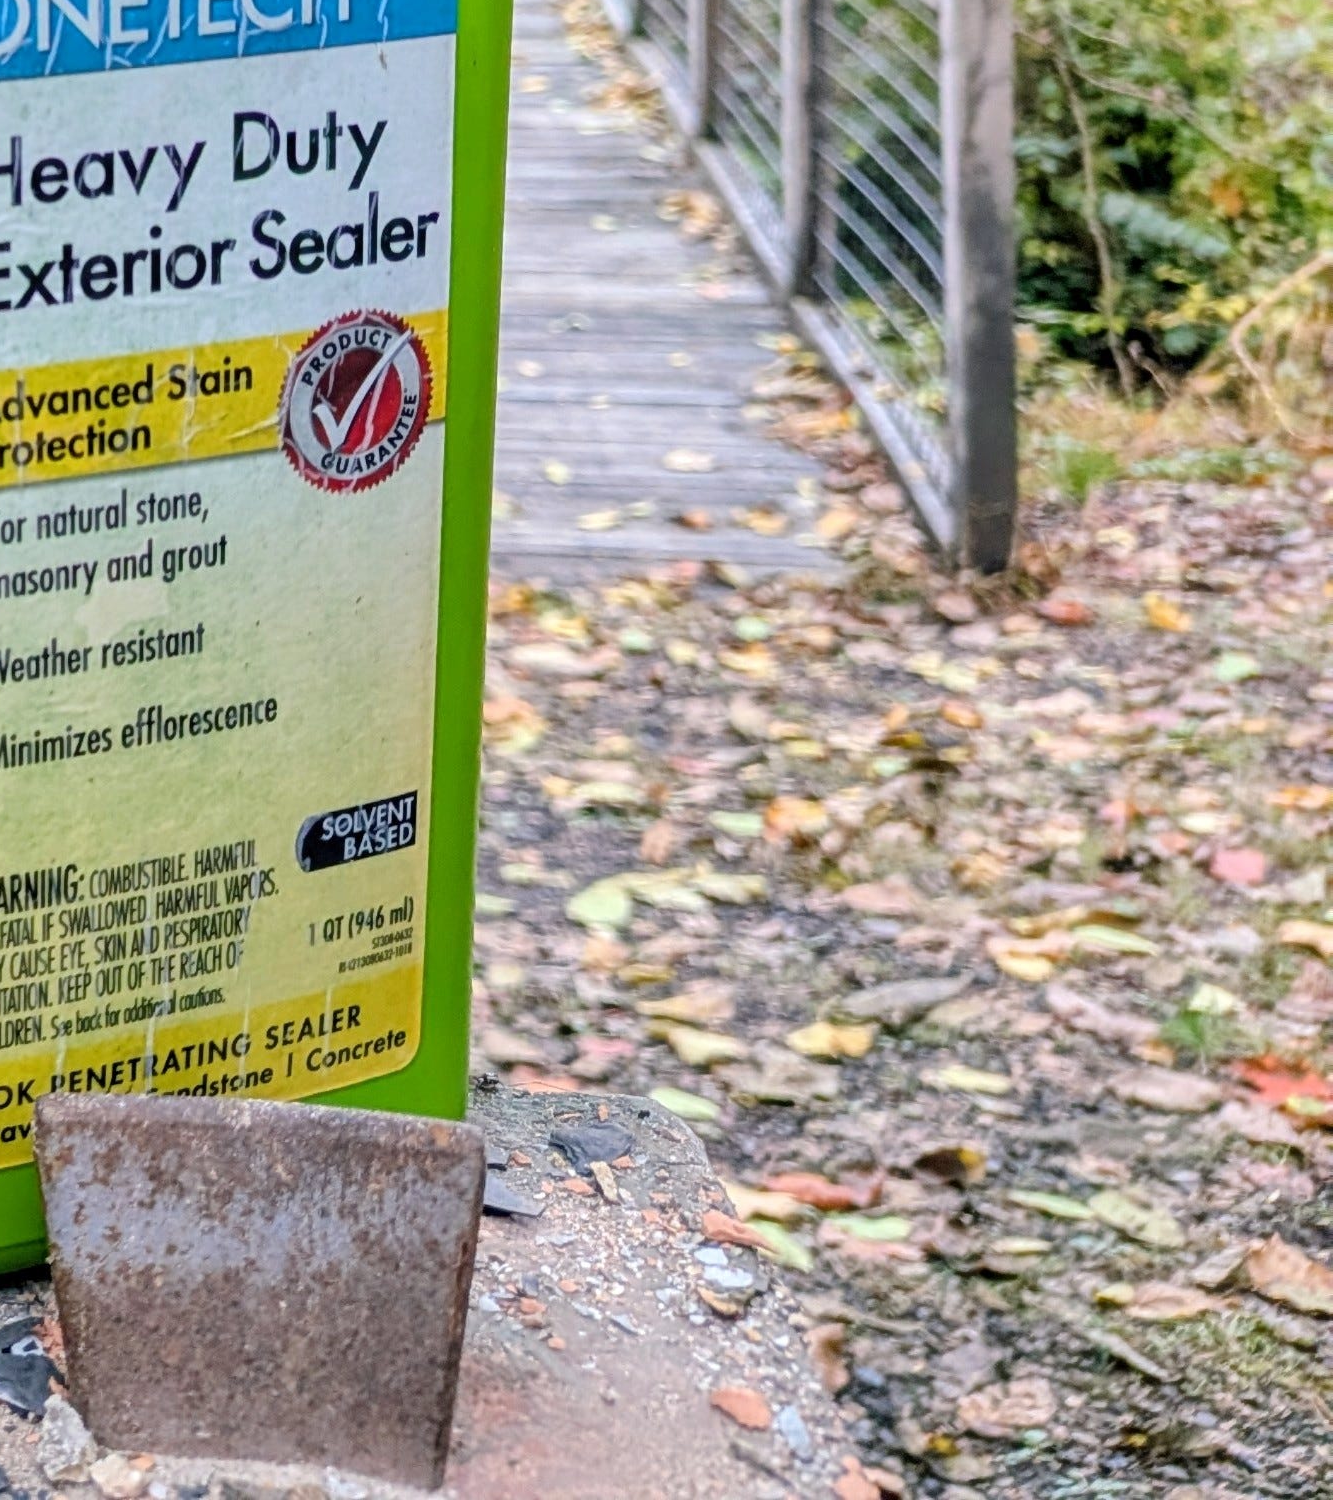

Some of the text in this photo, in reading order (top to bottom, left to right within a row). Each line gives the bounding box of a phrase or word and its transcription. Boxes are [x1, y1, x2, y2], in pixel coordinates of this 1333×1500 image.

[233, 111, 387, 191] Duty
[249, 192, 440, 280] Sealer
[167, 357, 252, 400] Stain
[301, 329, 392, 386] PRODUCT
[321, 394, 416, 474] GUARANTEE
[37, 489, 127, 540] natural
[137, 491, 208, 524] stone,
[107, 538, 152, 582] and
[162, 535, 227, 582] grout
[101, 622, 204, 668] resistant
[122, 698, 277, 748] efflorescence
[321, 796, 414, 840] SOLVENT
[343, 822, 413, 860] BASED
[194, 839, 257, 878] HARMFUL
[0, 915, 37, 950] FATAL
[42, 912, 54, 942] IF
[156, 880, 220, 919] HARMFUL
[224, 868, 279, 904] VAPORS.
[309, 896, 414, 946] 1 QT (946 ml)
[10, 946, 55, 981] CAUSE
[60, 940, 89, 973] EYE,
[94, 932, 126, 964] SKIN
[130, 926, 159, 957] AND
[164, 905, 251, 950] RESPIRATORY
[58, 973, 91, 1004] KEEP
[95, 965, 123, 997] OUT
[128, 961, 146, 990] OF
[151, 954, 176, 985] THE
[180, 944, 222, 980] REACH
[226, 939, 245, 969] OF
[51, 1015, 73, 1040] See
[76, 1007, 102, 1034] back
[105, 1003, 121, 1028] for
[51, 1033, 250, 1093] PENETRATING
[265, 1005, 361, 1050] SEALER
[306, 1028, 407, 1071] Concrete
